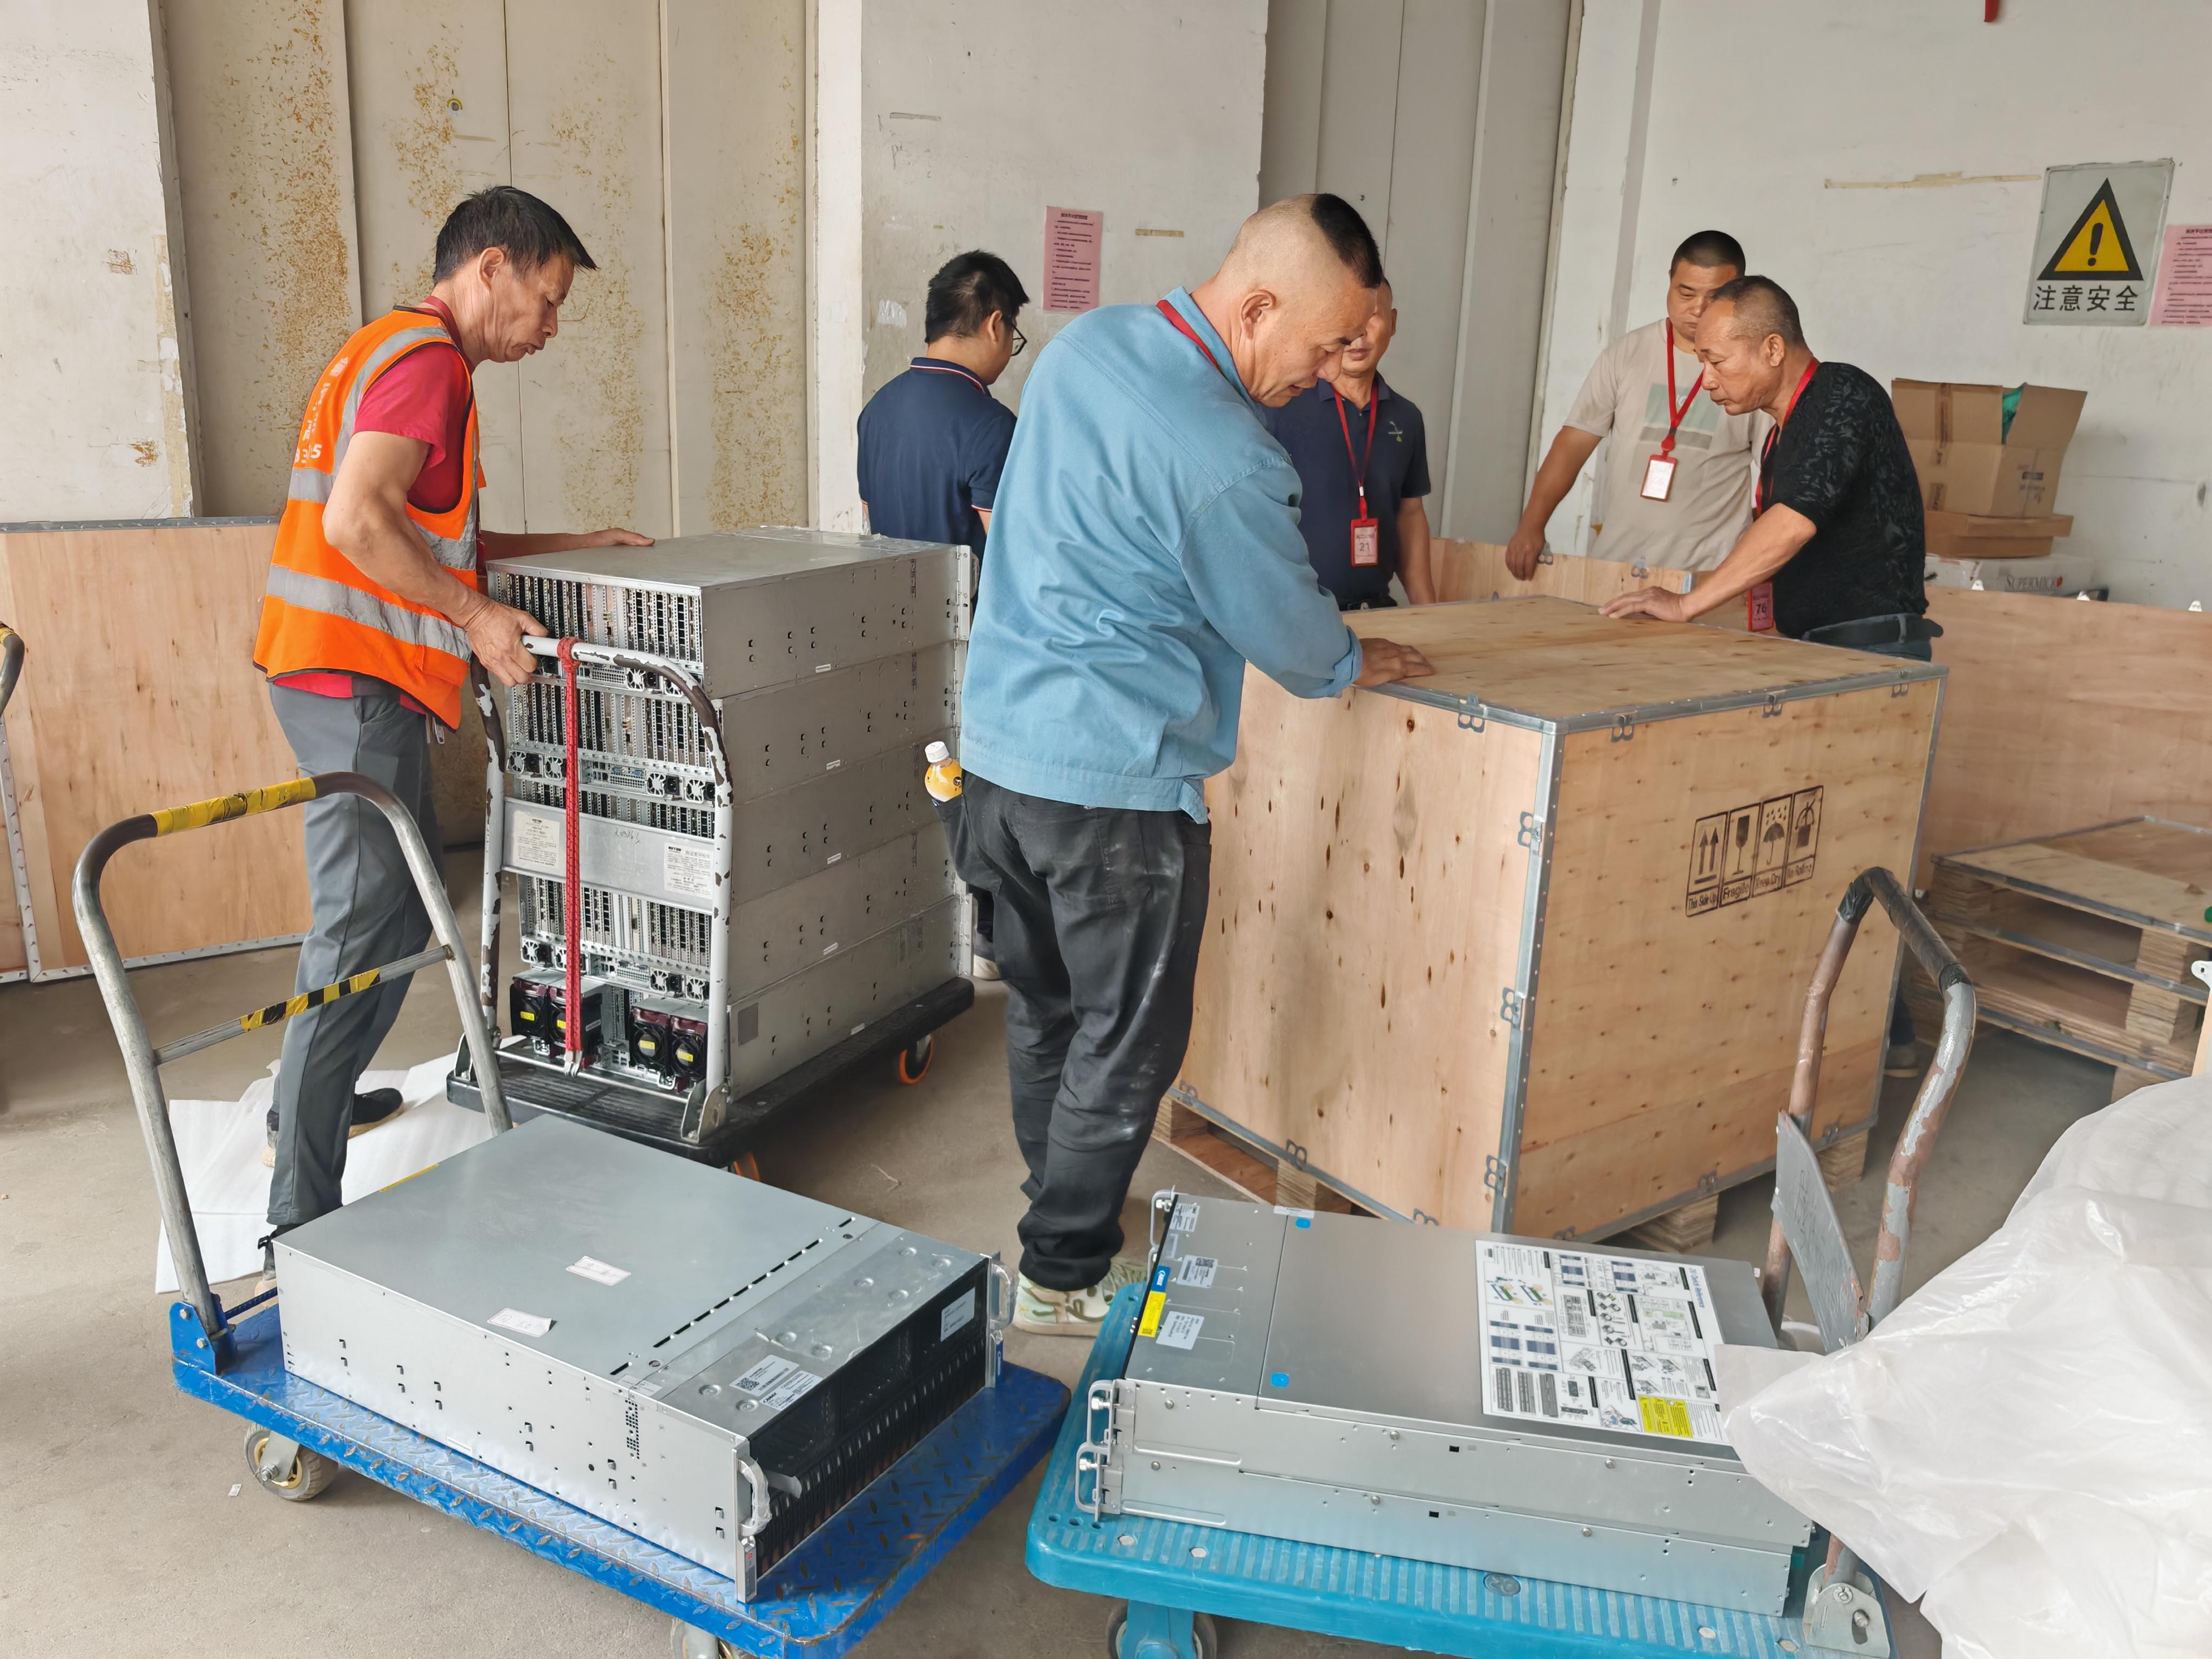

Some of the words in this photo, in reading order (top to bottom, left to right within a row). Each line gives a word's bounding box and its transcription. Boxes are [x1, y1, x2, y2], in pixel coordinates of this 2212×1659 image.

[2033, 285, 2139, 312] 注意安全
[1755, 603, 1767, 614] 76
[1723, 882, 1749, 899] Fragile
[1689, 896, 1697, 909] This
[1699, 894, 1709, 906] Side
[1710, 891, 1717, 905] Up
